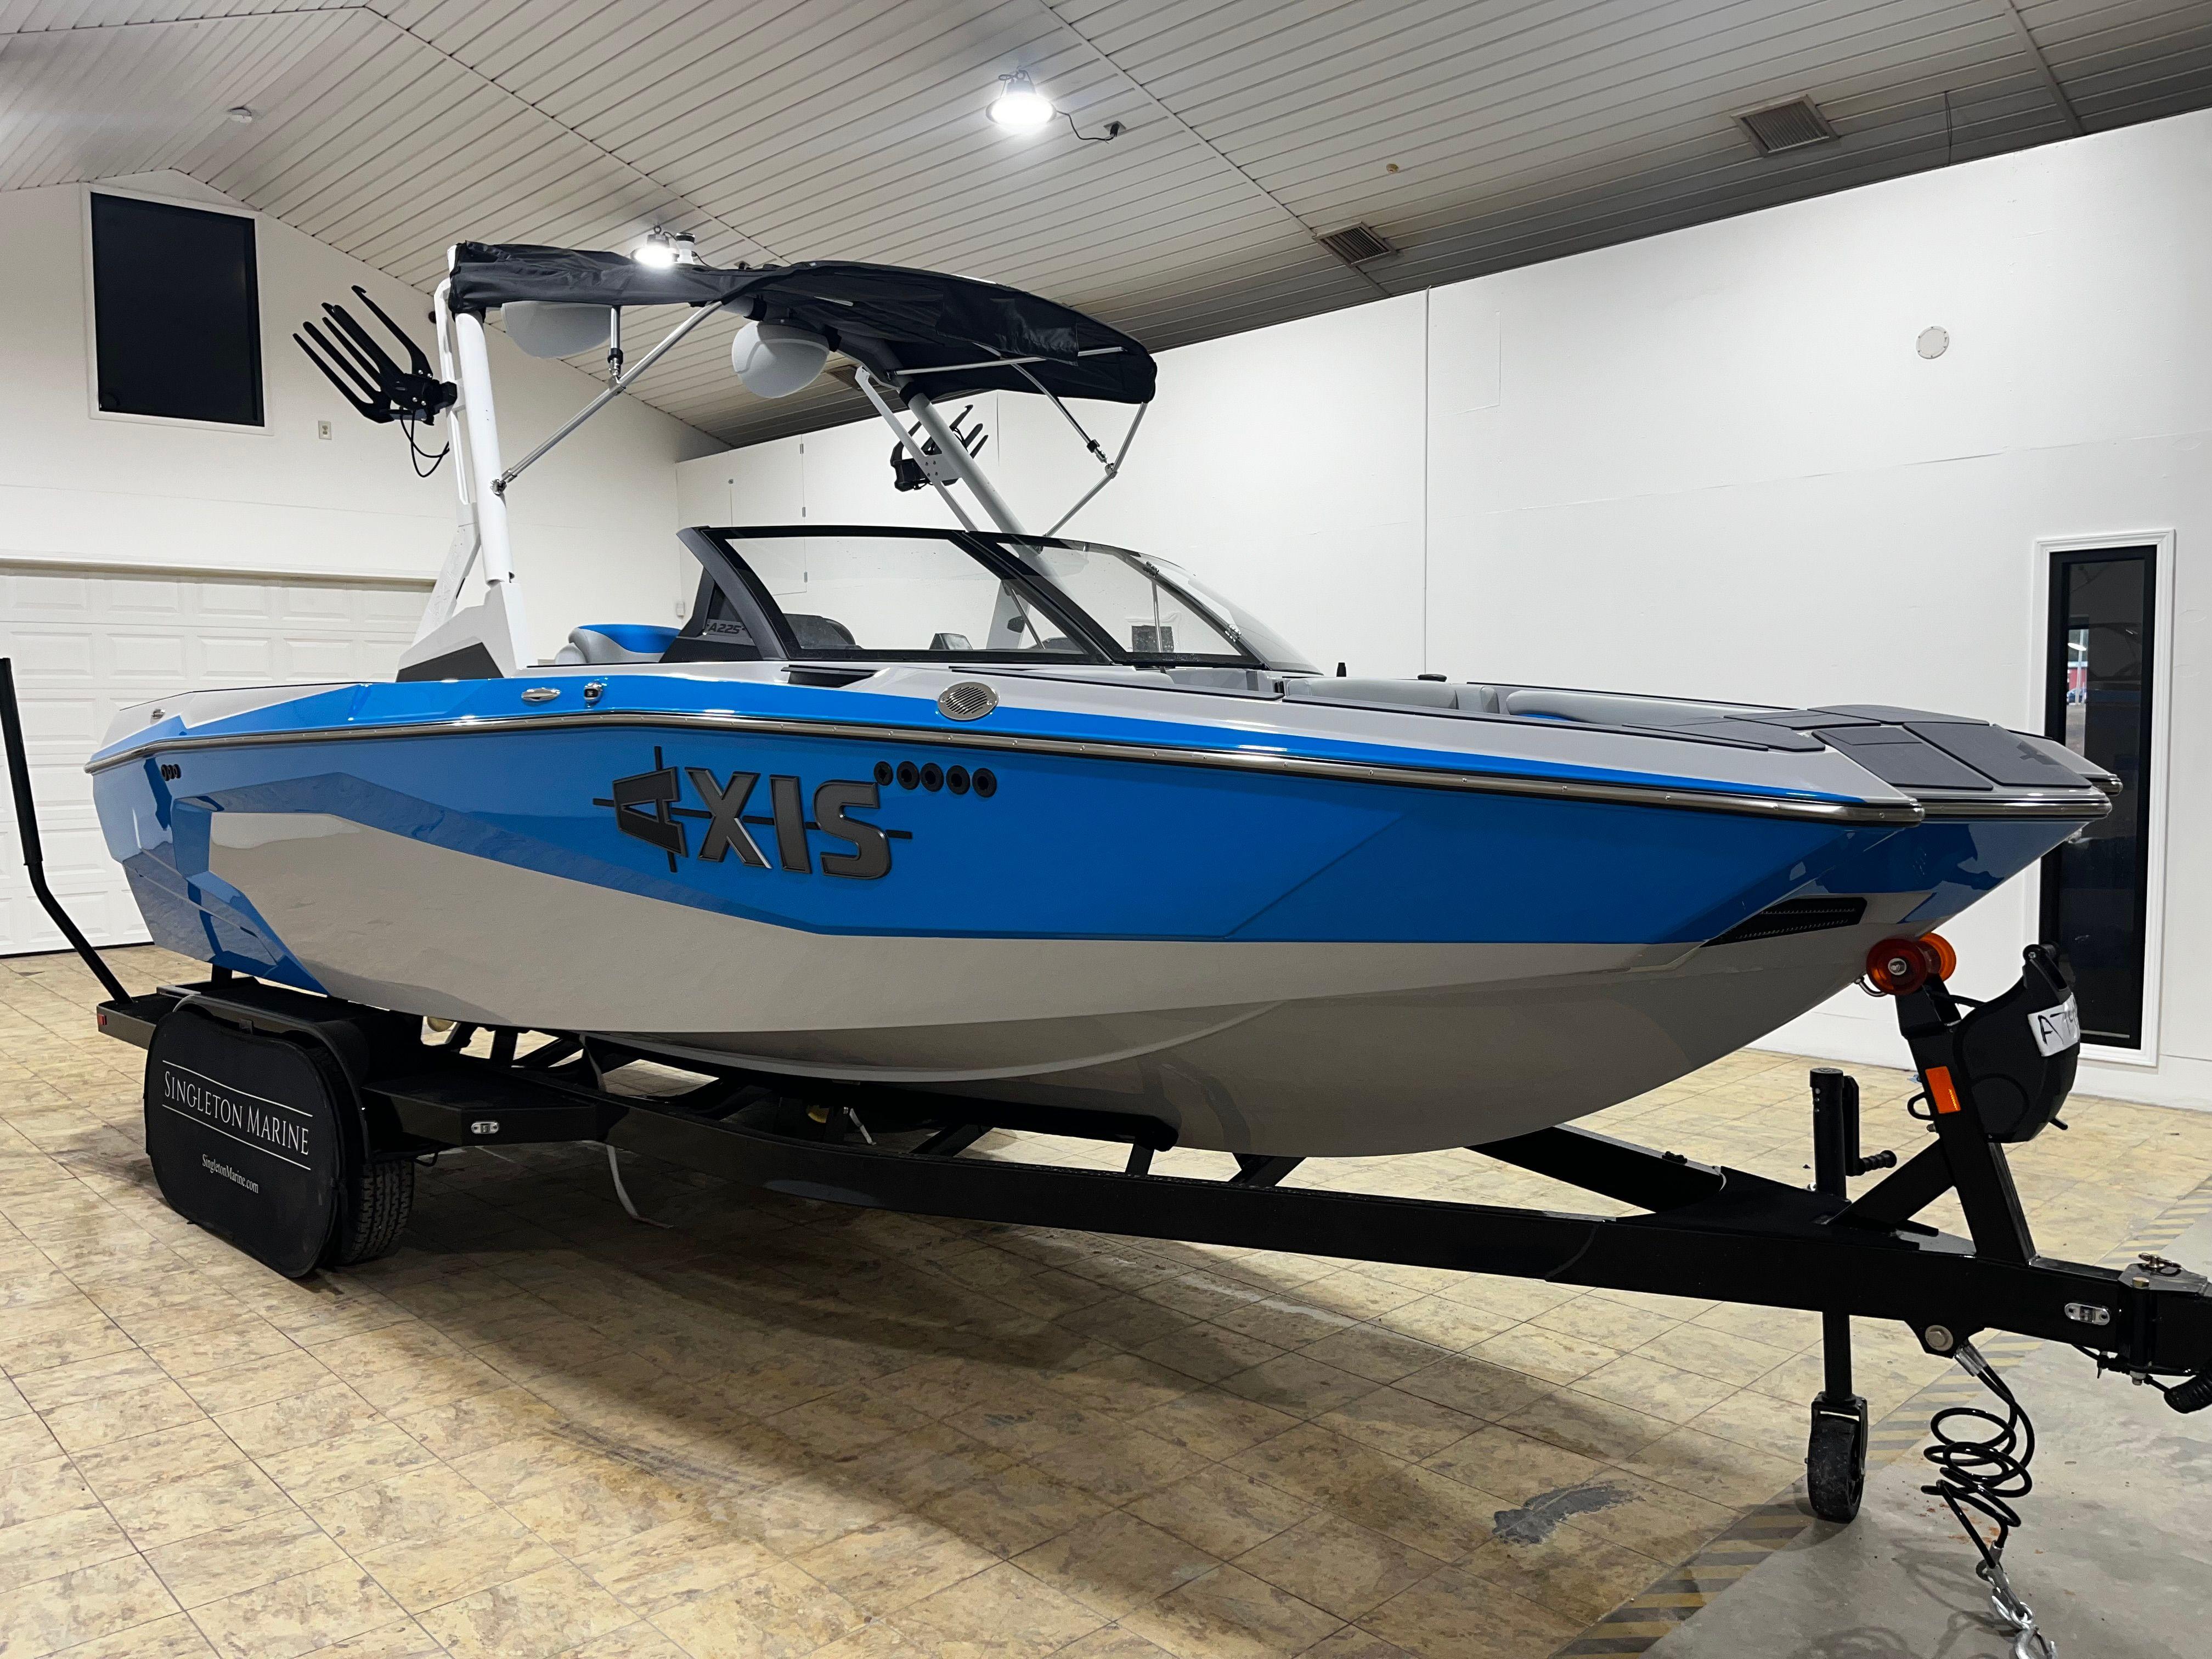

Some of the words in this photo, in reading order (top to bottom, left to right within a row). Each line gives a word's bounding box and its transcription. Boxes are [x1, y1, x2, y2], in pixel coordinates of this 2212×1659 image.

[708, 622, 742, 634] A225
[611, 765, 893, 881] AXIS
[165, 1071, 242, 1129] SINGLETON
[247, 1105, 309, 1155] MARINE
[202, 1154, 259, 1194] SingletonMarine.com
